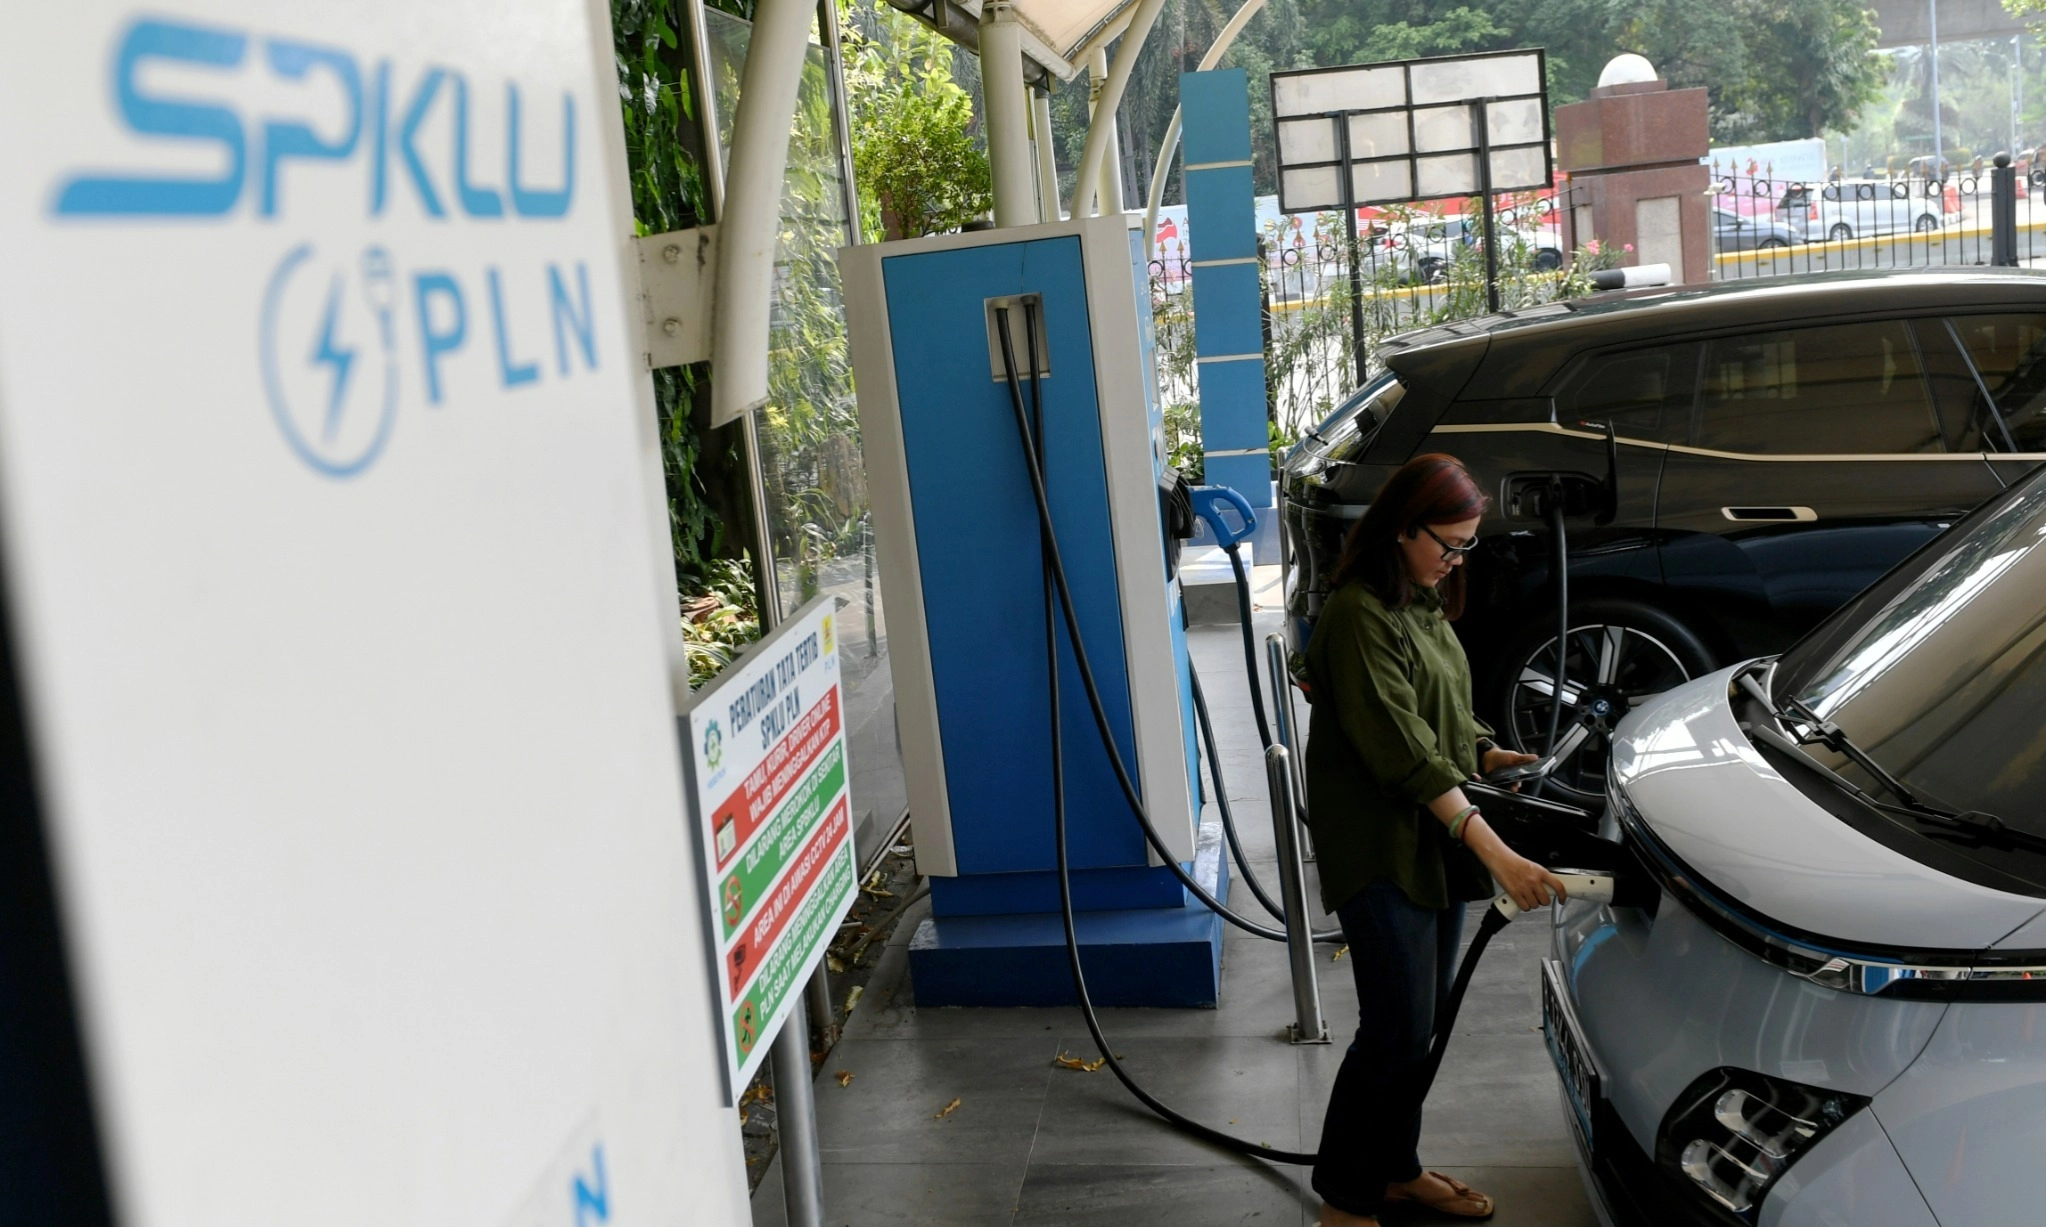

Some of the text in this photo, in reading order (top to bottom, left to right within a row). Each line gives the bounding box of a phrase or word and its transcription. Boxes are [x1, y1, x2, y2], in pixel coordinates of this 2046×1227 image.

[50, 17, 578, 221] SPKLU
[411, 259, 602, 408] PLN
[729, 629, 818, 737] PERATURAN TATA TERTIB
[760, 685, 800, 751] SPKLU PLN
[766, 736, 789, 780] KURIR,
[788, 713, 811, 753] DRIVER
[810, 691, 831, 729] ONLINE
[745, 743, 840, 875] DILARANG MEROKOK DI SEKITAR
[748, 715, 831, 825] WAJIB MENINGGALKAN KTP
[753, 803, 844, 949] AREA INI DI AWASI CCTV 24 JAM
[778, 822, 796, 861] AREA
[759, 842, 848, 995] DILARANG MENINGGALKAN AREA
[760, 861, 850, 1022] PLN SAAT MELAKUKAN CHARGING
